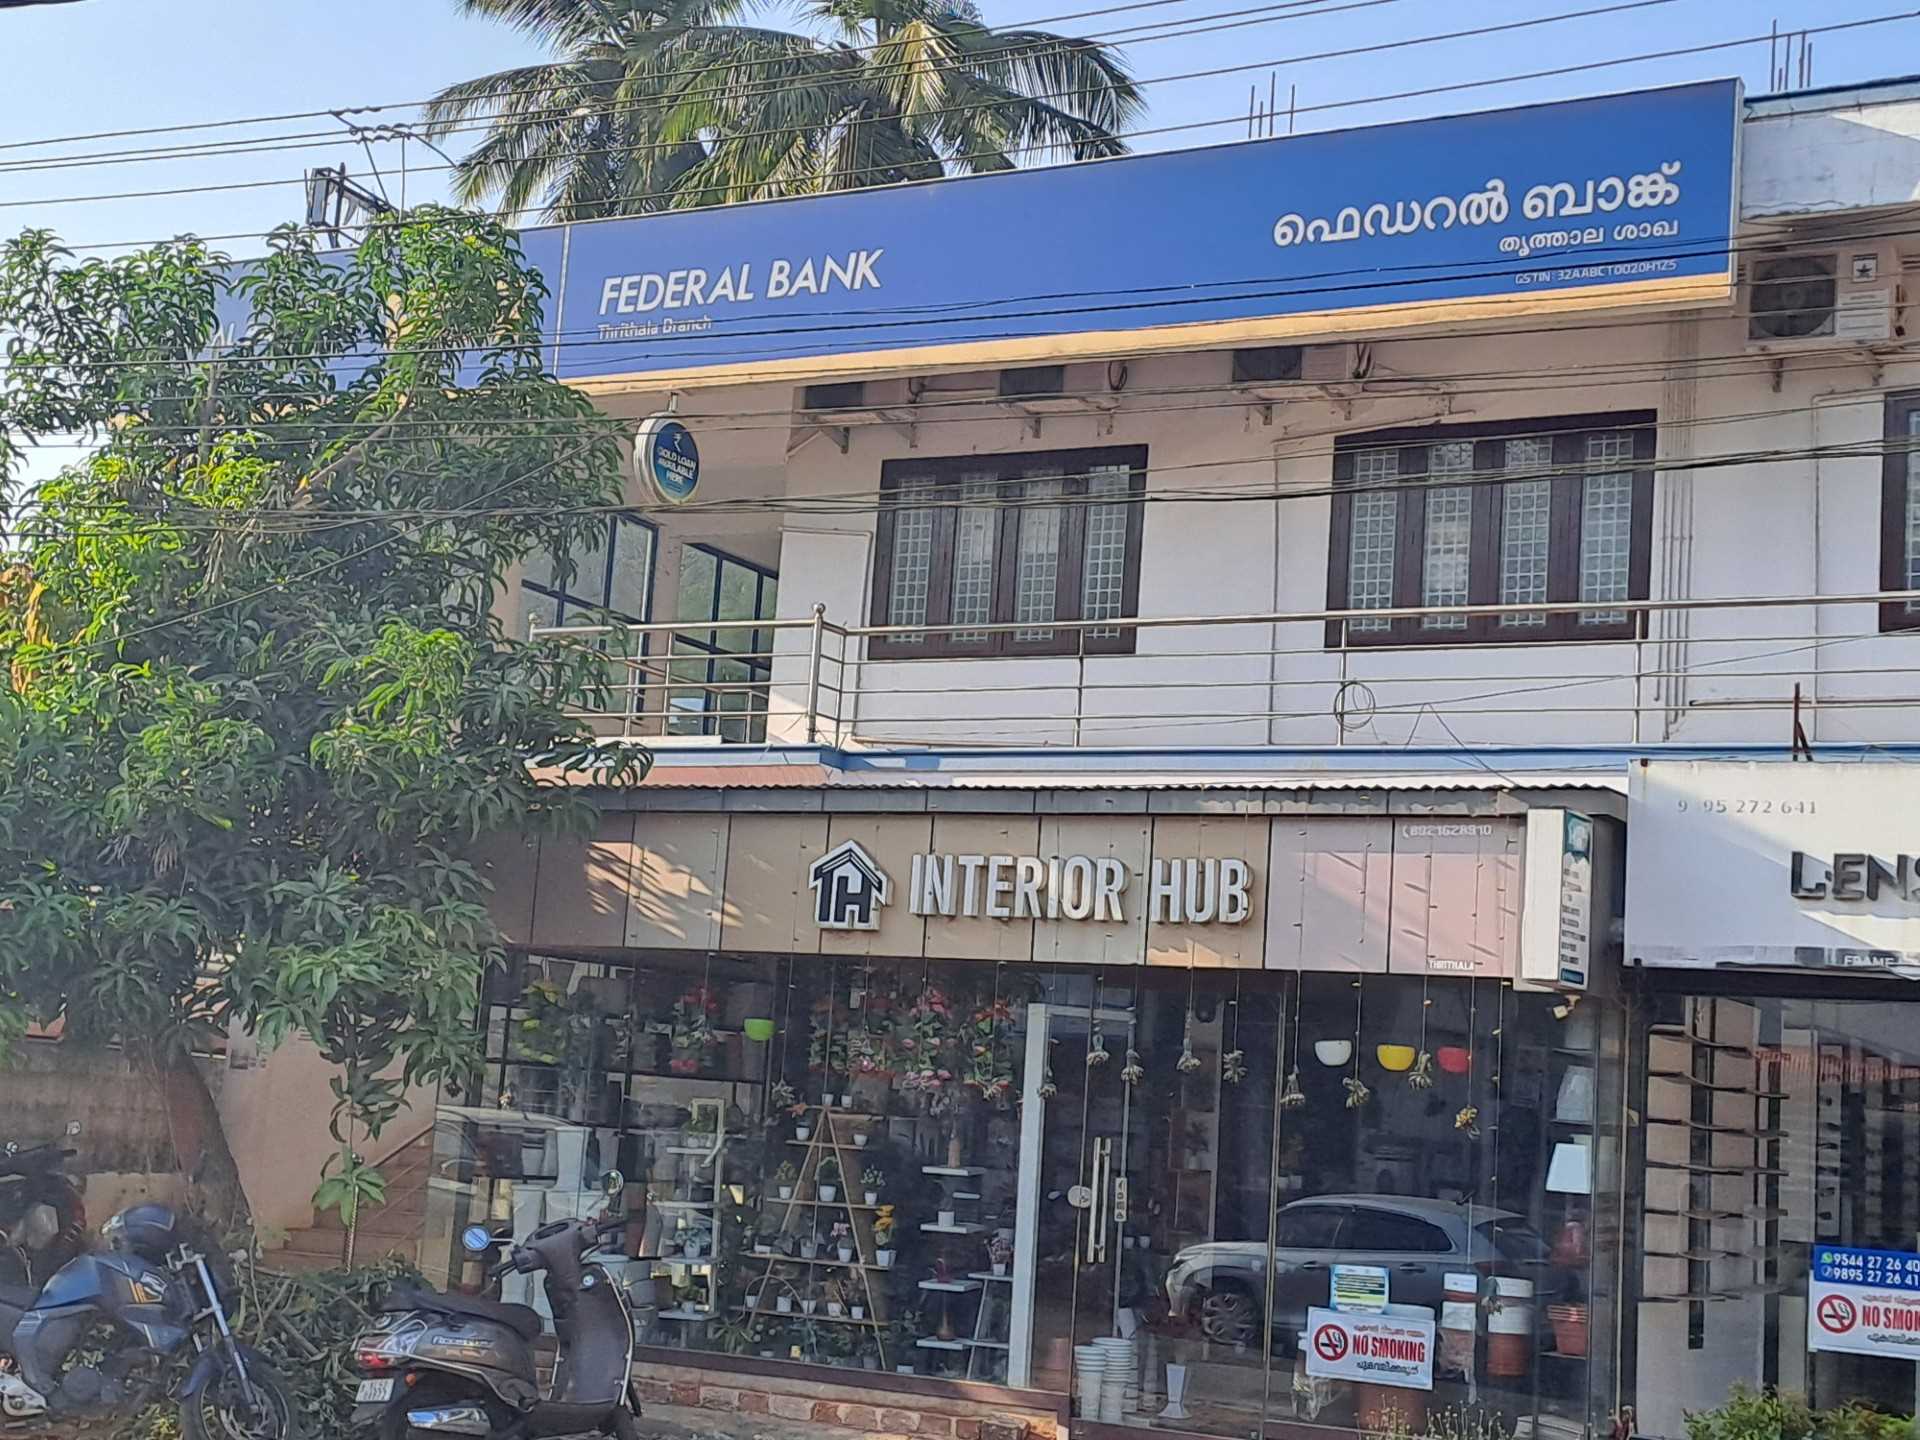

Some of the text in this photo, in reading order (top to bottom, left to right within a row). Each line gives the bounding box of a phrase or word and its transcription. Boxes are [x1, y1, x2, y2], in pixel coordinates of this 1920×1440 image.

[1272, 160, 1682, 248] ഫെഡറൽ ബാങ്ക്
[1613, 219, 1679, 241] ശാഖ
[598, 249, 884, 315] FEDERAL BANK
[662, 314, 713, 336] Branch
[1736, 800, 1772, 814] 272
[909, 853, 1255, 924] INTERIOR HUB
[1833, 1253, 1863, 1267] 9544
[1867, 1256, 1882, 1269] 27
[1886, 1258, 1901, 1270] 26
[1833, 1267, 1919, 1287] 9895 27 26 41
[1862, 1305, 1880, 1328] NO
[1352, 1334, 1426, 1363] NO SMOKING
